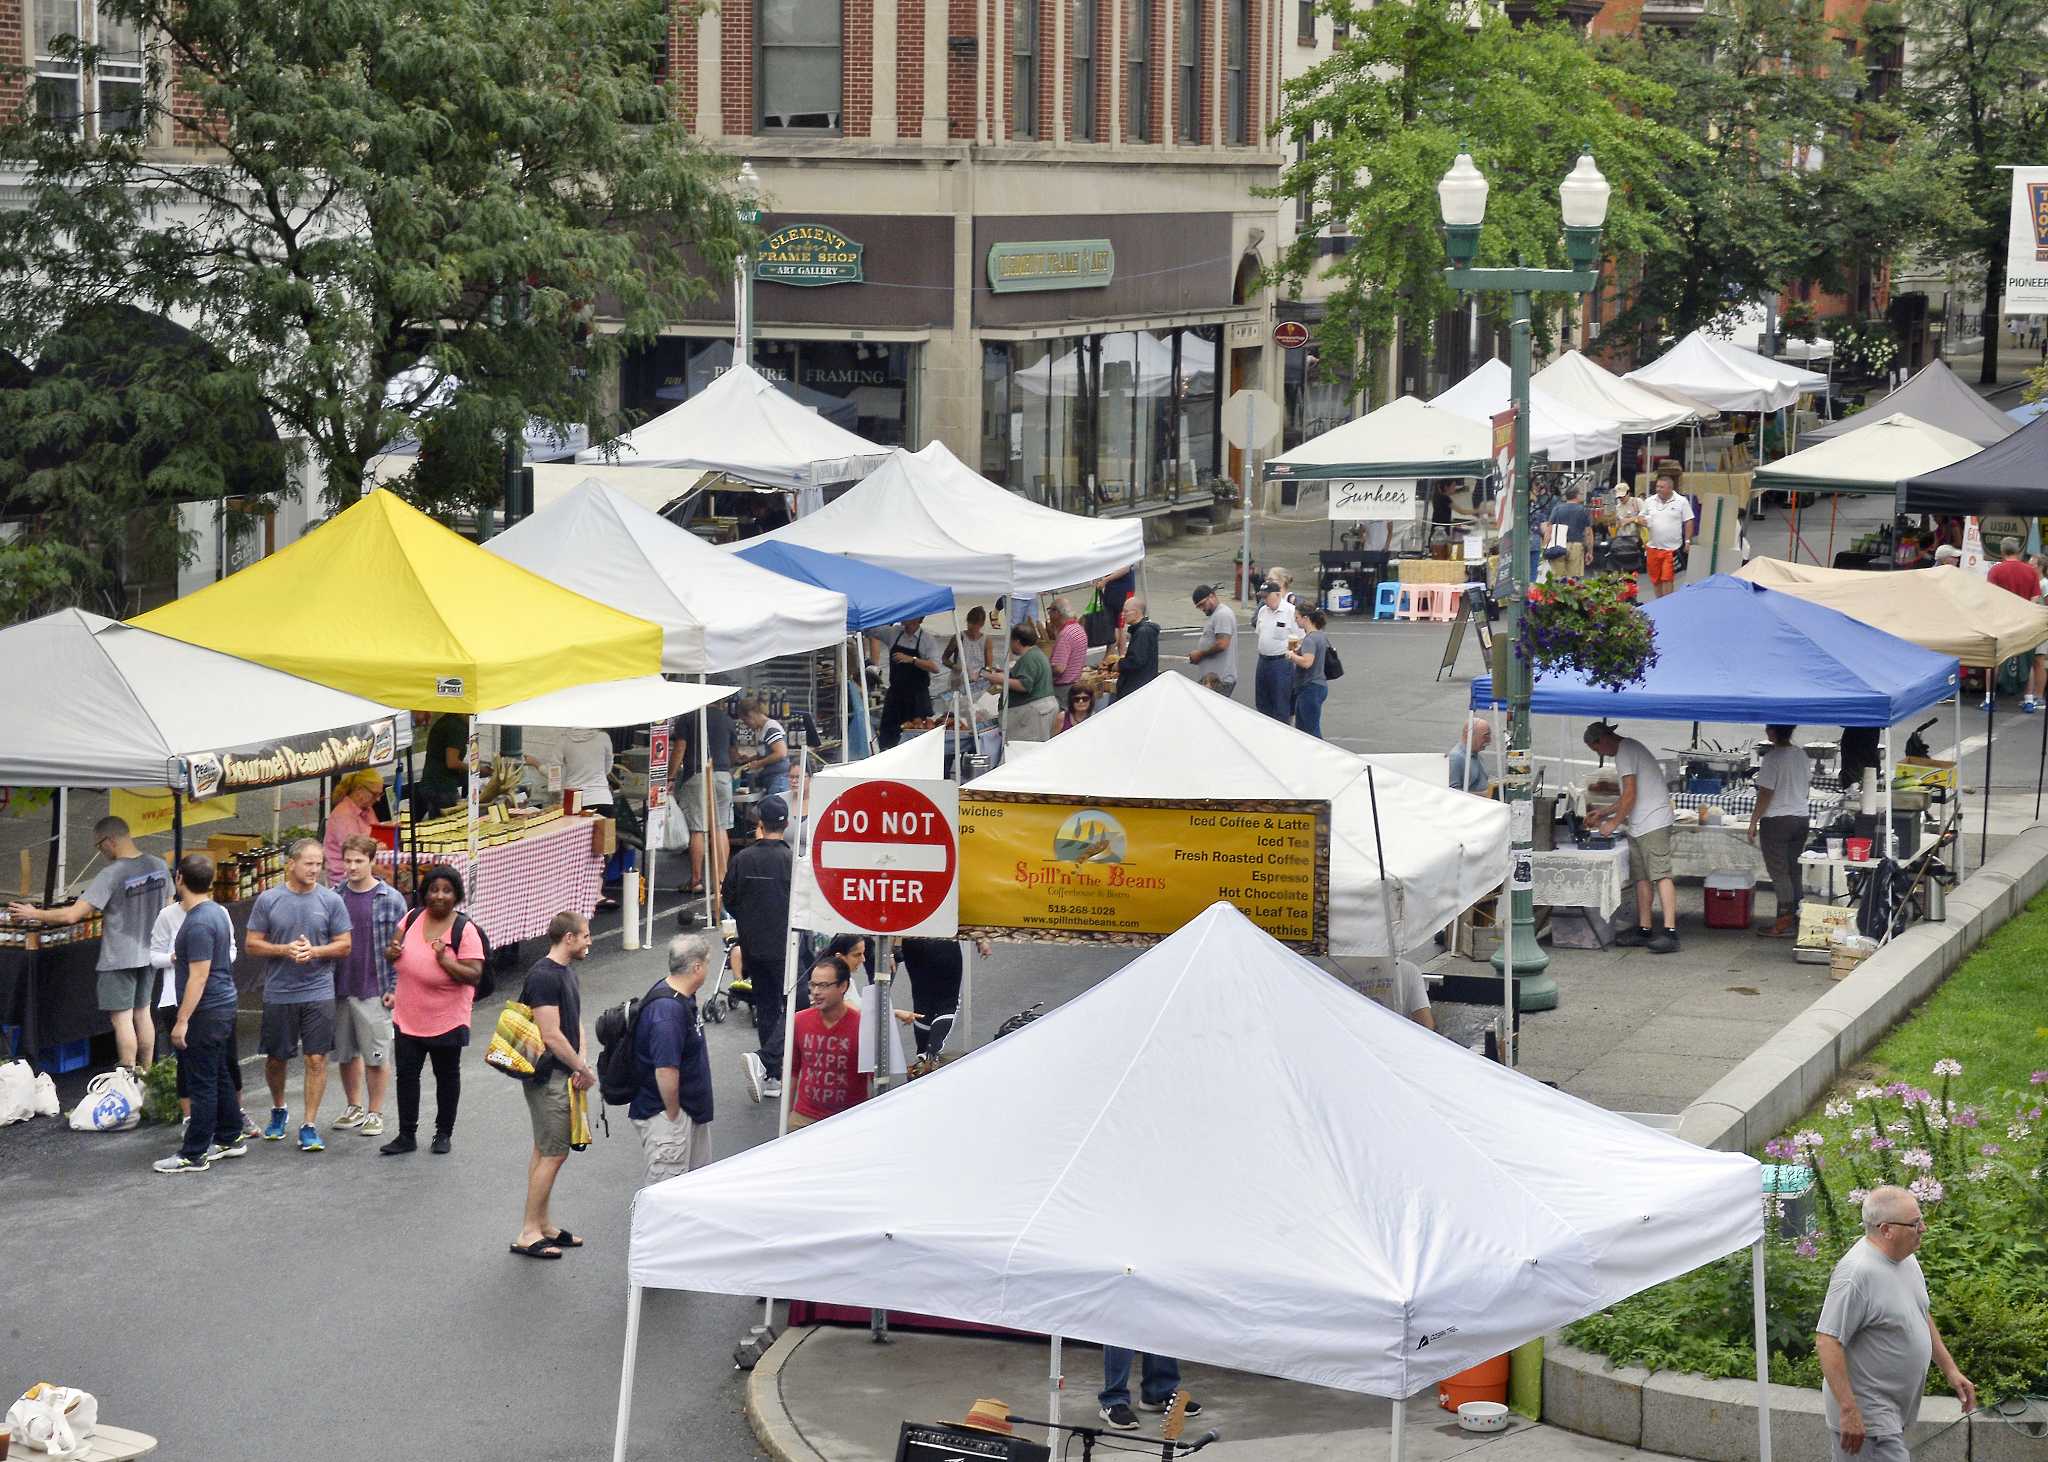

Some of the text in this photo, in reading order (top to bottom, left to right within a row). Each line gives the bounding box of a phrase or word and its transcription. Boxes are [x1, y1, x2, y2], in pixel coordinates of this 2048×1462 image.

[769, 228, 847, 250] CLEMENT
[758, 251, 857, 262] FRAME SHOP
[777, 266, 838, 276] ART GALLERY
[805, 369, 885, 384] FRAMING
[1991, 520, 2018, 532] USDA
[223, 752, 289, 784] Gourmet
[281, 745, 336, 776] Peanut
[328, 735, 374, 766] Butter
[833, 810, 935, 836] DO NOT
[1190, 815, 1310, 831] Iced Coffee & Latte
[1257, 836, 1310, 848] Iced Tea
[1174, 849, 1310, 866] Fresh Roasted Coffee
[1077, 873, 1101, 888] The
[1107, 864, 1166, 890] Beans
[1252, 870, 1309, 884] Espresso
[843, 878, 923, 903] ENTER
[1219, 887, 1309, 901] Hot Chocolate
[1048, 904, 1116, 916] 518-268-1028
[1255, 906, 1283, 918] Leaf
[1287, 907, 1308, 919] Tea
